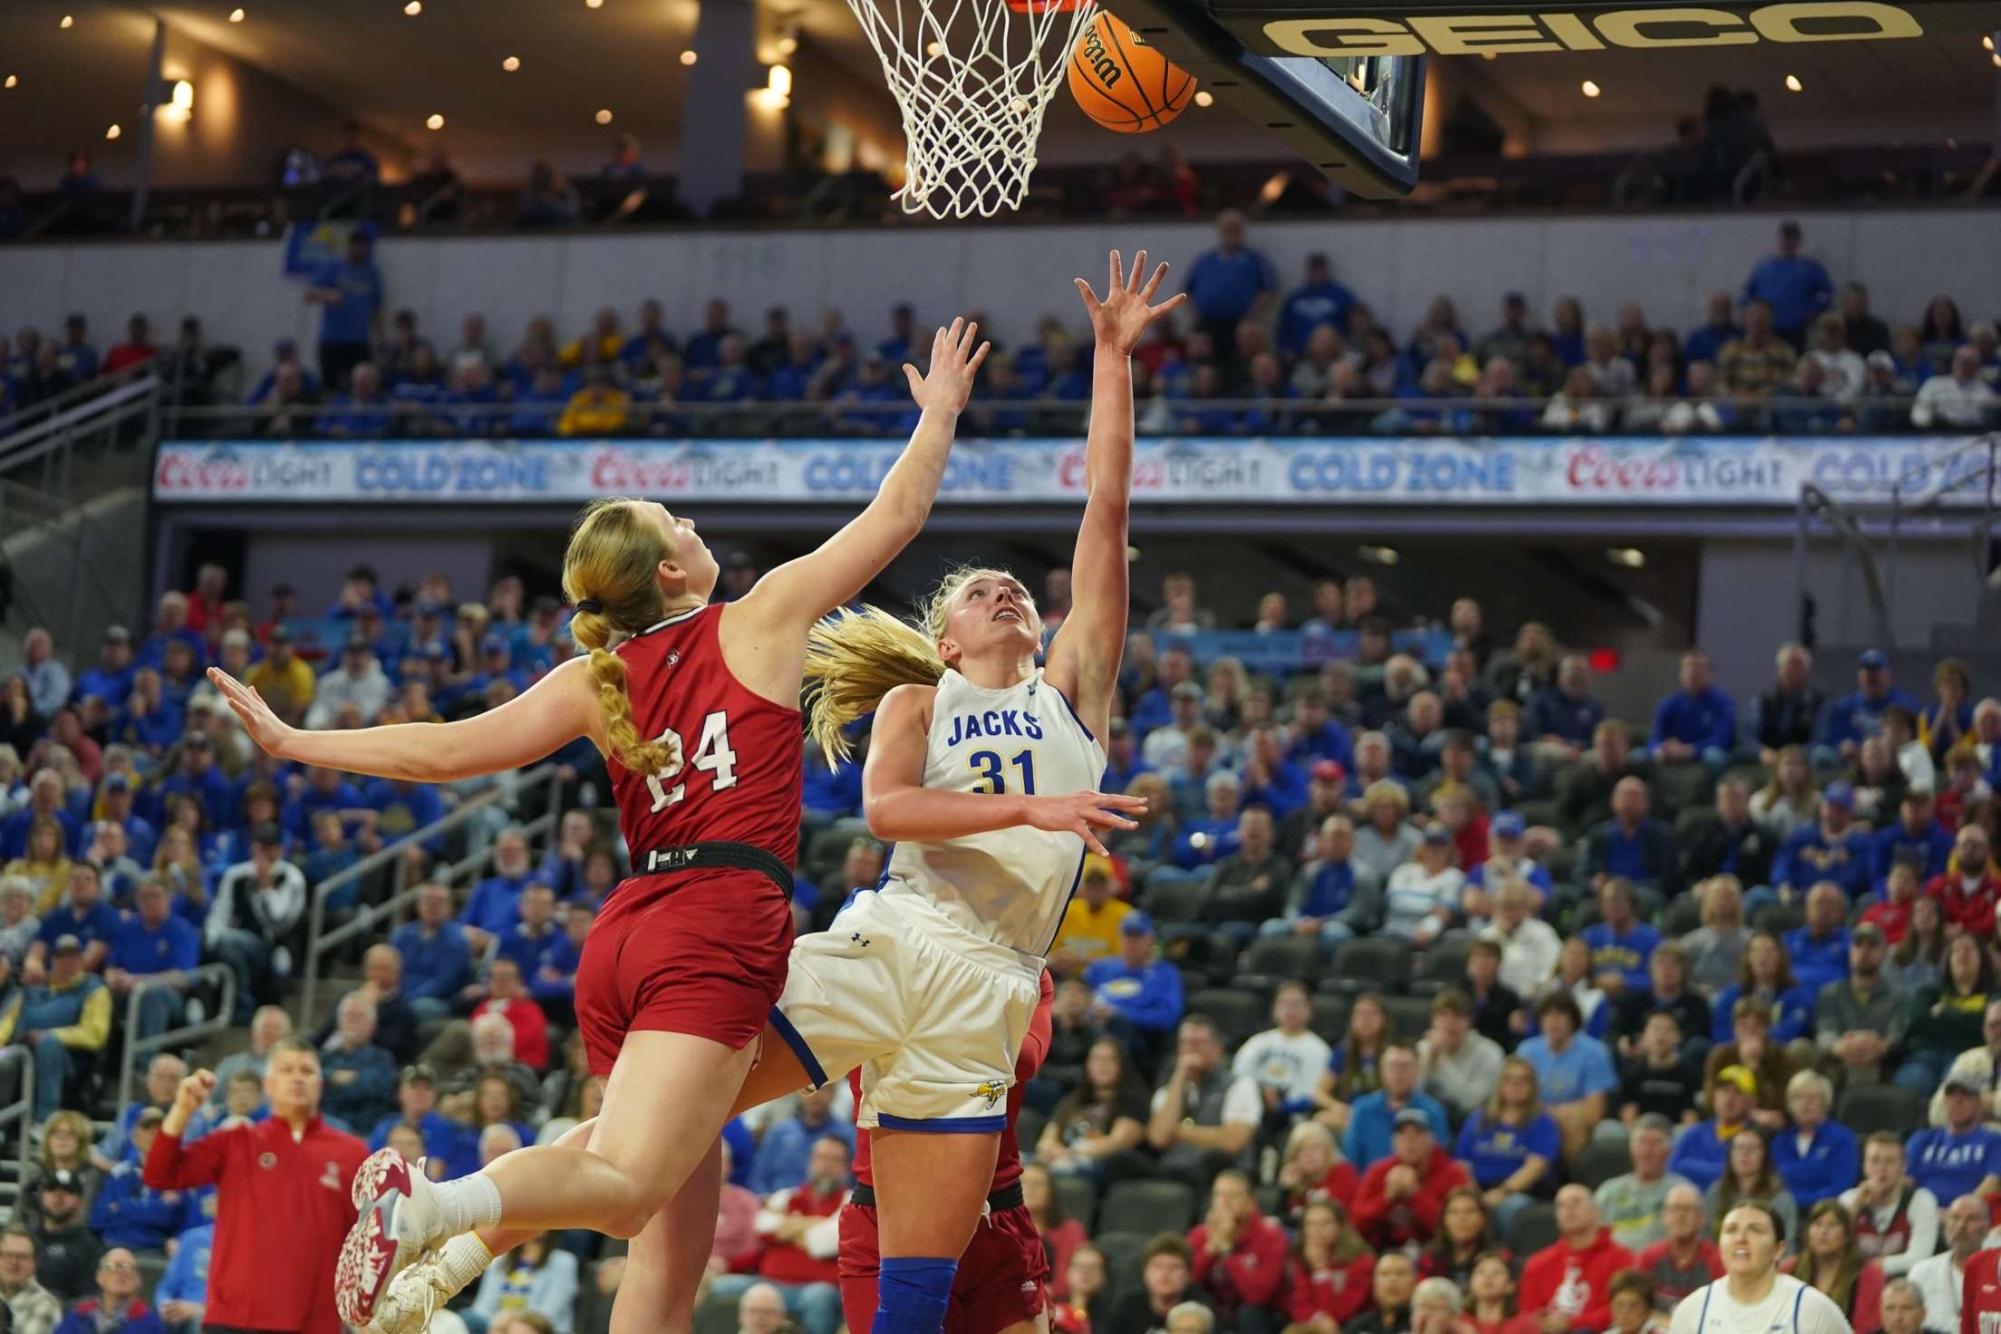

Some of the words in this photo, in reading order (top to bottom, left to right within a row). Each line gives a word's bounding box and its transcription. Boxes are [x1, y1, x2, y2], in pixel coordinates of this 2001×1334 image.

[1263, 1, 1924, 57] GEICO
[1083, 25, 1121, 90] Wilso
[356, 453, 450, 491] COLD
[454, 453, 549, 491] ZONE
[1289, 453, 1399, 491] COLD
[1406, 453, 1516, 491] ZONE
[1684, 457, 1782, 487] LIGHT
[947, 709, 1043, 747] JACKS
[646, 710, 738, 813] 24
[968, 748, 1036, 796] 31
